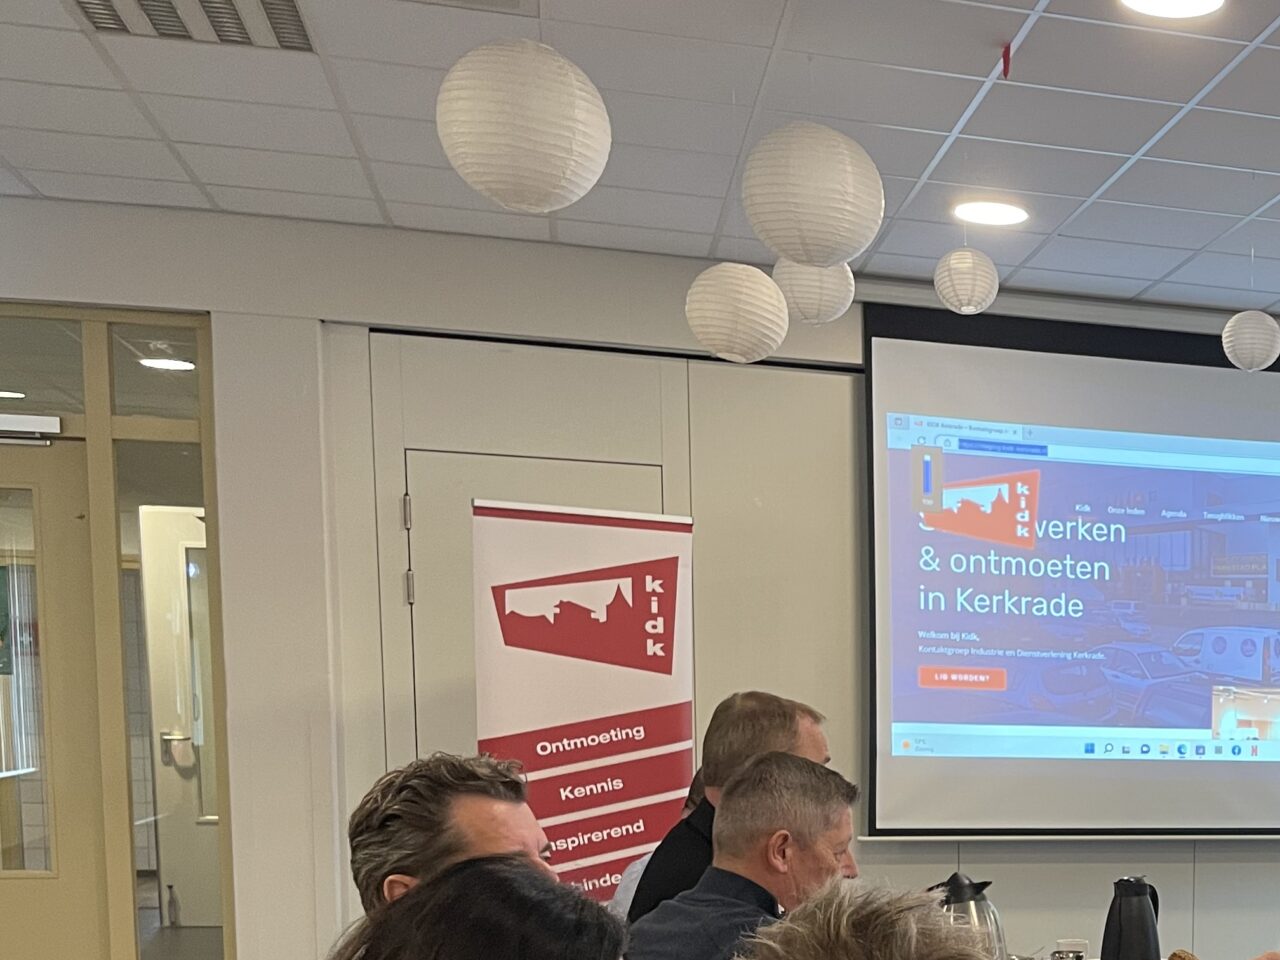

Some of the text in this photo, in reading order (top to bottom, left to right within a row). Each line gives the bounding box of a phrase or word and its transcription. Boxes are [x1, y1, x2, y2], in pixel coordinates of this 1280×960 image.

[919, 545, 1111, 581] & ontmoeten
[644, 574, 665, 657] kidk
[919, 584, 1084, 618] in Kerkrade
[536, 723, 646, 756] Ontmoeting
[559, 776, 624, 801] Kennis
[551, 819, 645, 851] nspirerend
